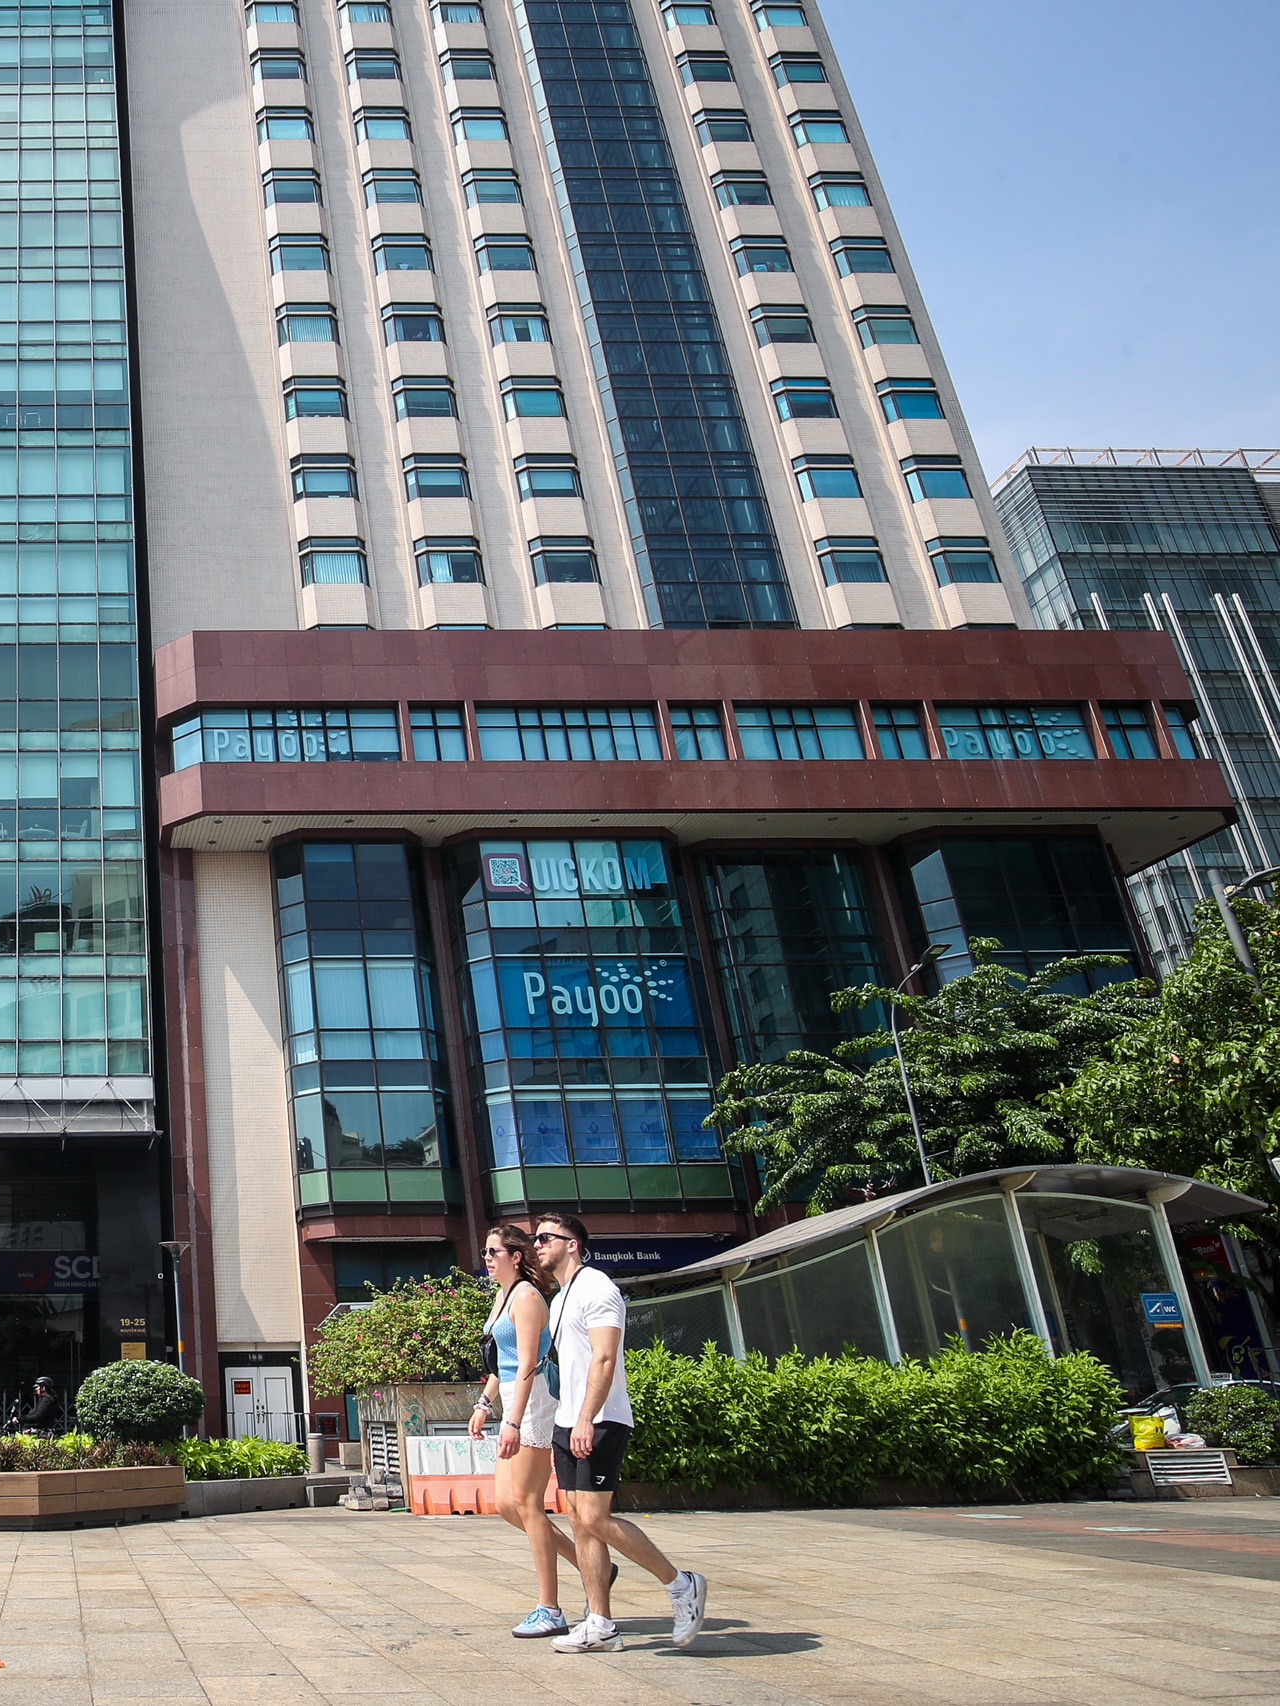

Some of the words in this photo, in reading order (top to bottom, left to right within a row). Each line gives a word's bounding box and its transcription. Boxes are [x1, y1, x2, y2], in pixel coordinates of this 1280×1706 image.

[214, 729, 318, 761] Payoo
[523, 972, 643, 1027] Payoo
[594, 1251, 634, 1262] Bangkok
[636, 1251, 661, 1260] Bank
[120, 1318, 146, 1326] 19-25
